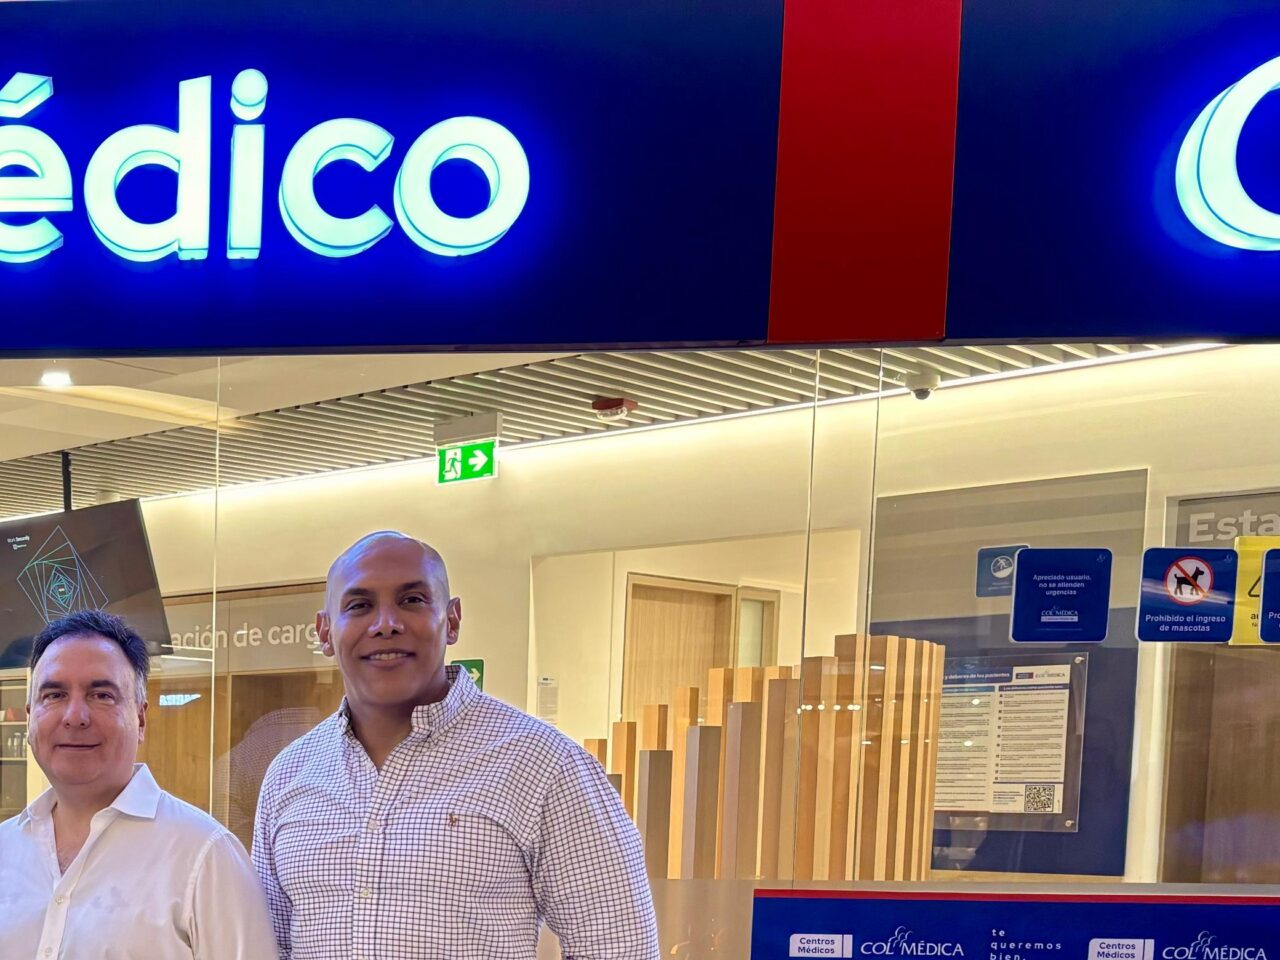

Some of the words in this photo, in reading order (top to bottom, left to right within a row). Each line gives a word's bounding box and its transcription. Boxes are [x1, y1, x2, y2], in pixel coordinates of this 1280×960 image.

[1032, 574, 1065, 582] Apreciado
[1145, 614, 1185, 622] Prohibido
[1195, 615, 1226, 624] ingreso
[233, 622, 262, 647] de
[991, 928, 1005, 937] te
[799, 937, 835, 946] Centros
[990, 941, 1062, 950] queremos
[1099, 941, 1136, 950] Centros
[797, 945, 835, 954] Médicos
[989, 953, 1026, 960] bien.
[1096, 950, 1136, 959] Médicos
